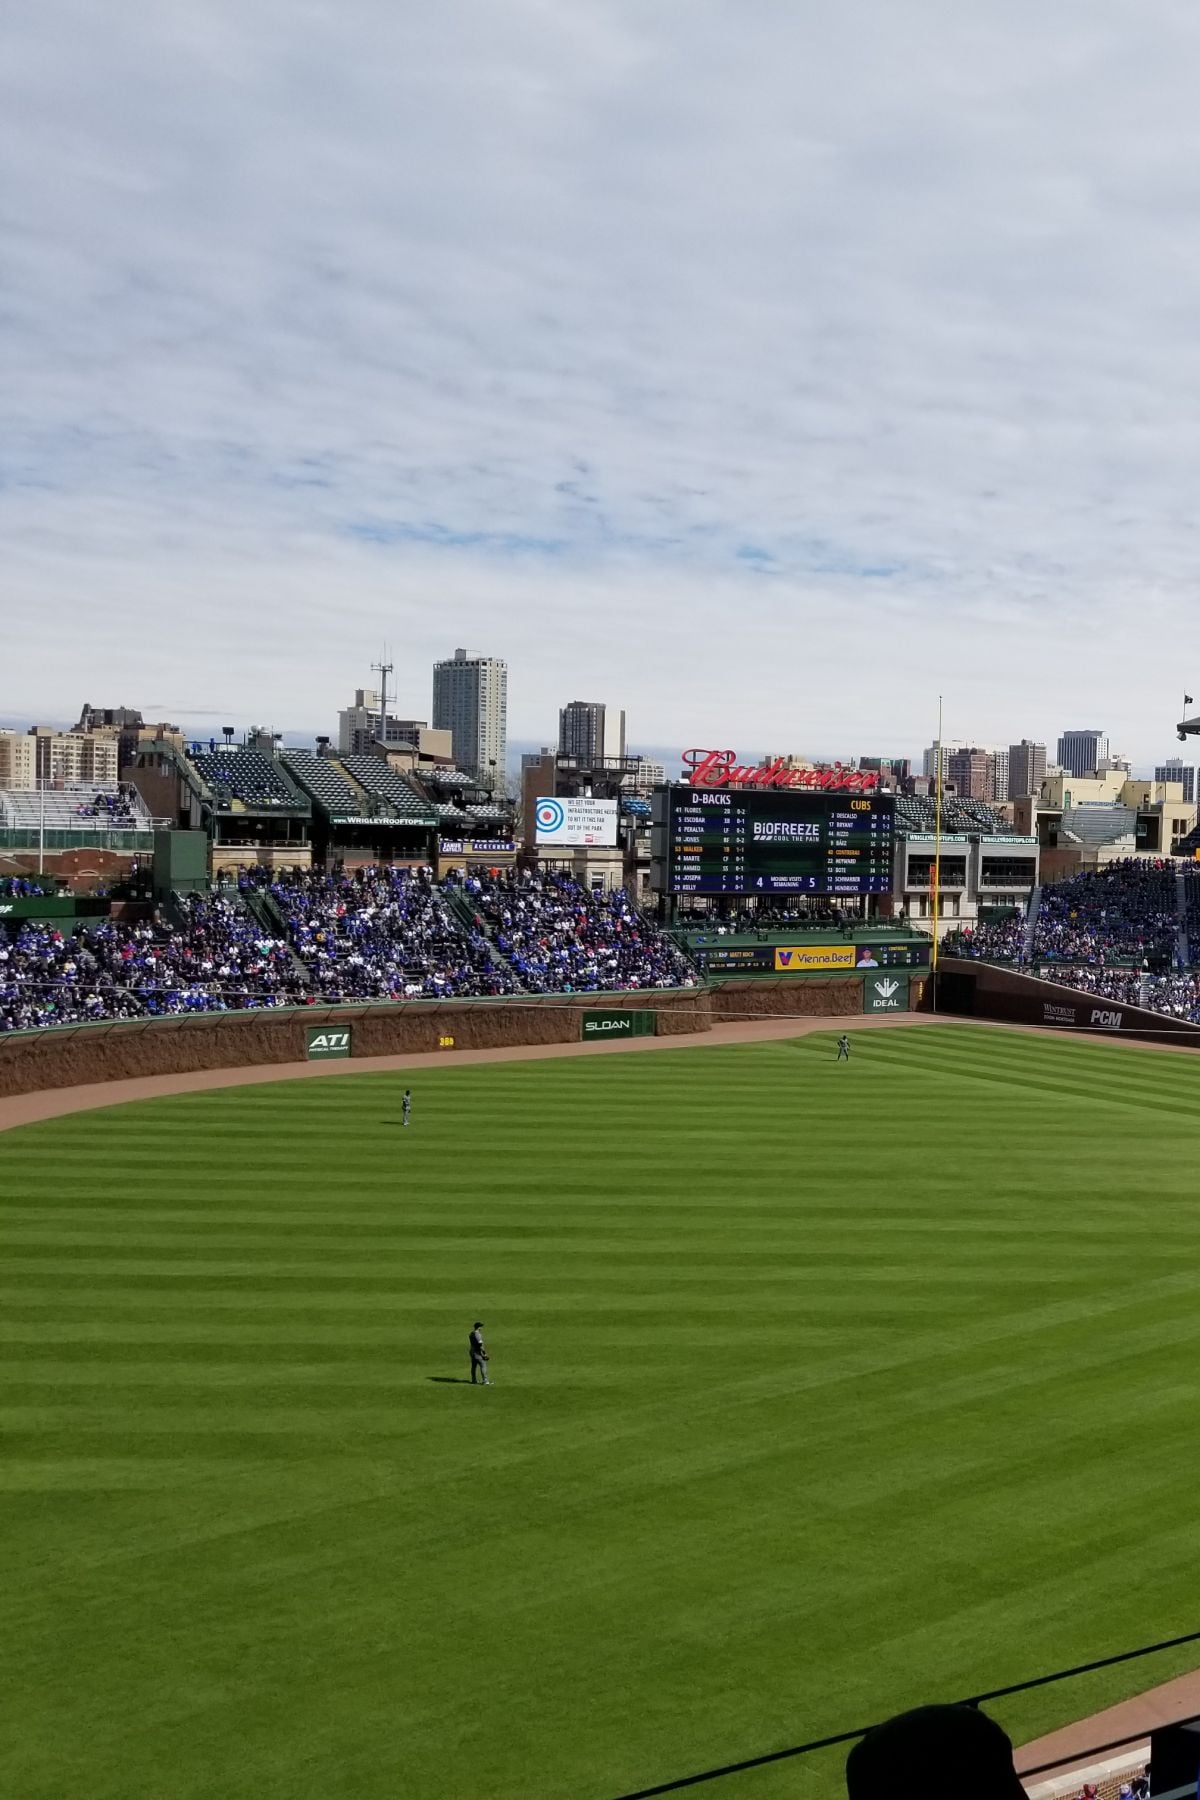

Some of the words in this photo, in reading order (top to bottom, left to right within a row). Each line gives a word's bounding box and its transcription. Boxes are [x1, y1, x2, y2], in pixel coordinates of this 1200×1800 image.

[682, 748, 880, 790] Budweiser
[692, 793, 731, 804] D-BACKS
[850, 800, 872, 810] CUBS
[753, 822, 820, 836] BiOFREEZE
[757, 876, 763, 887] 4
[809, 878, 815, 887] 5
[798, 953, 830, 963] Vienna
[832, 953, 853, 964] Beef
[872, 999, 900, 1007] IDEAL
[1043, 1004, 1076, 1016] WINTRUST
[1090, 1010, 1122, 1025] PCM
[585, 1020, 630, 1031] SLOAN
[309, 1034, 350, 1048] ATI
